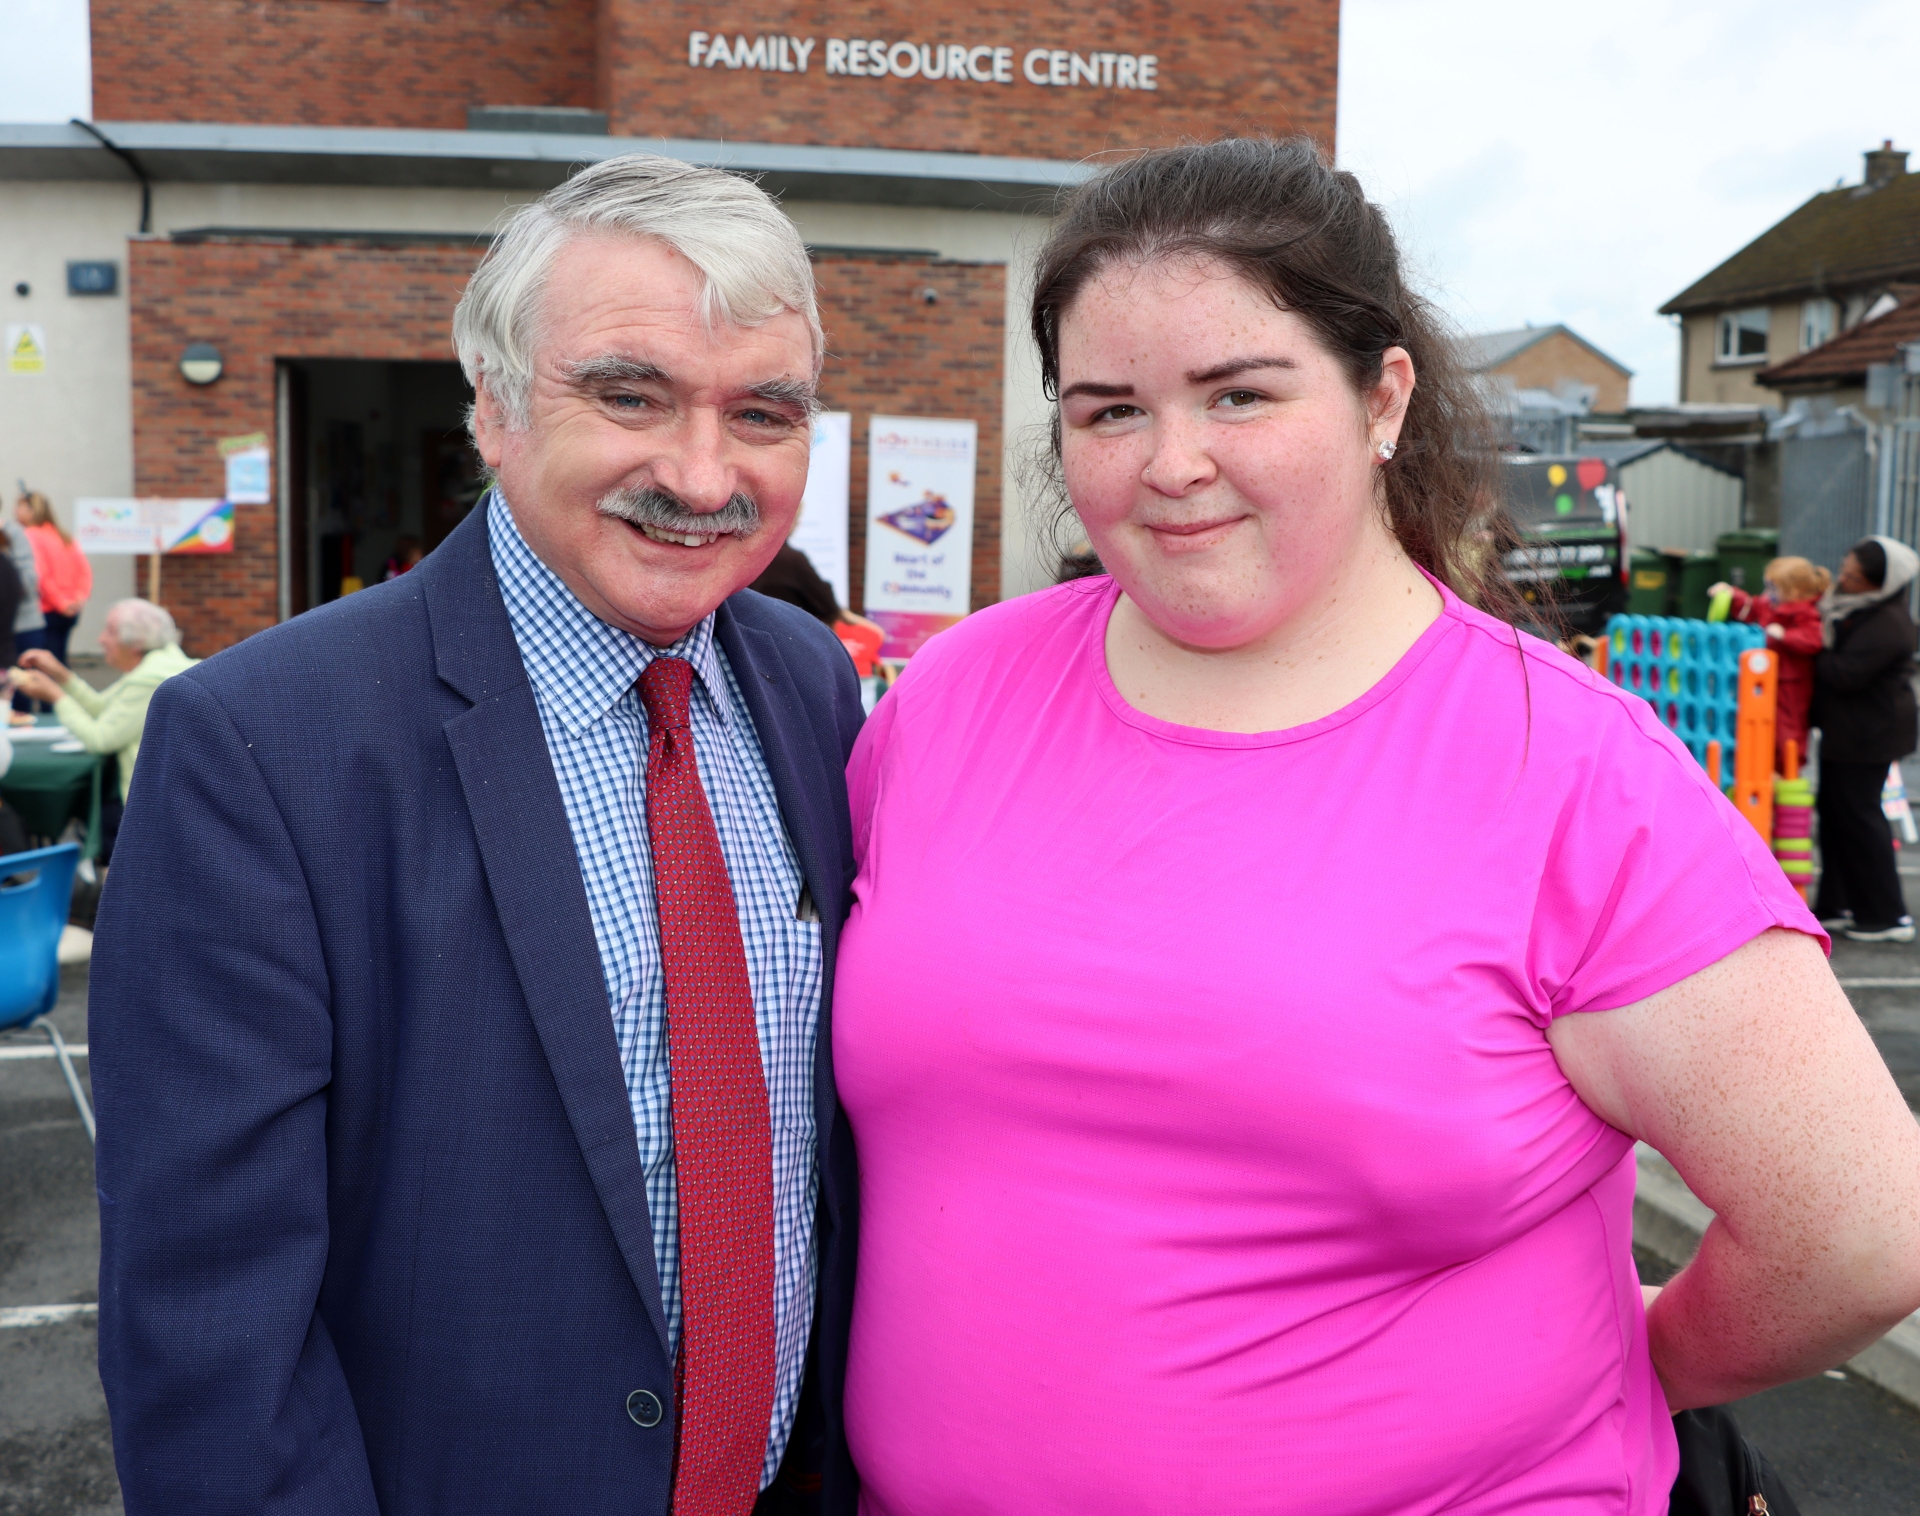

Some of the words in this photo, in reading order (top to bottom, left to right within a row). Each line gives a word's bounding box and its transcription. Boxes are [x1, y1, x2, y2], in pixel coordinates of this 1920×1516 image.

[689, 31, 815, 73] FAMILY
[826, 38, 1014, 83] RESOURCE
[1023, 48, 1158, 90] CENTRE
[882, 582, 951, 600] Community
